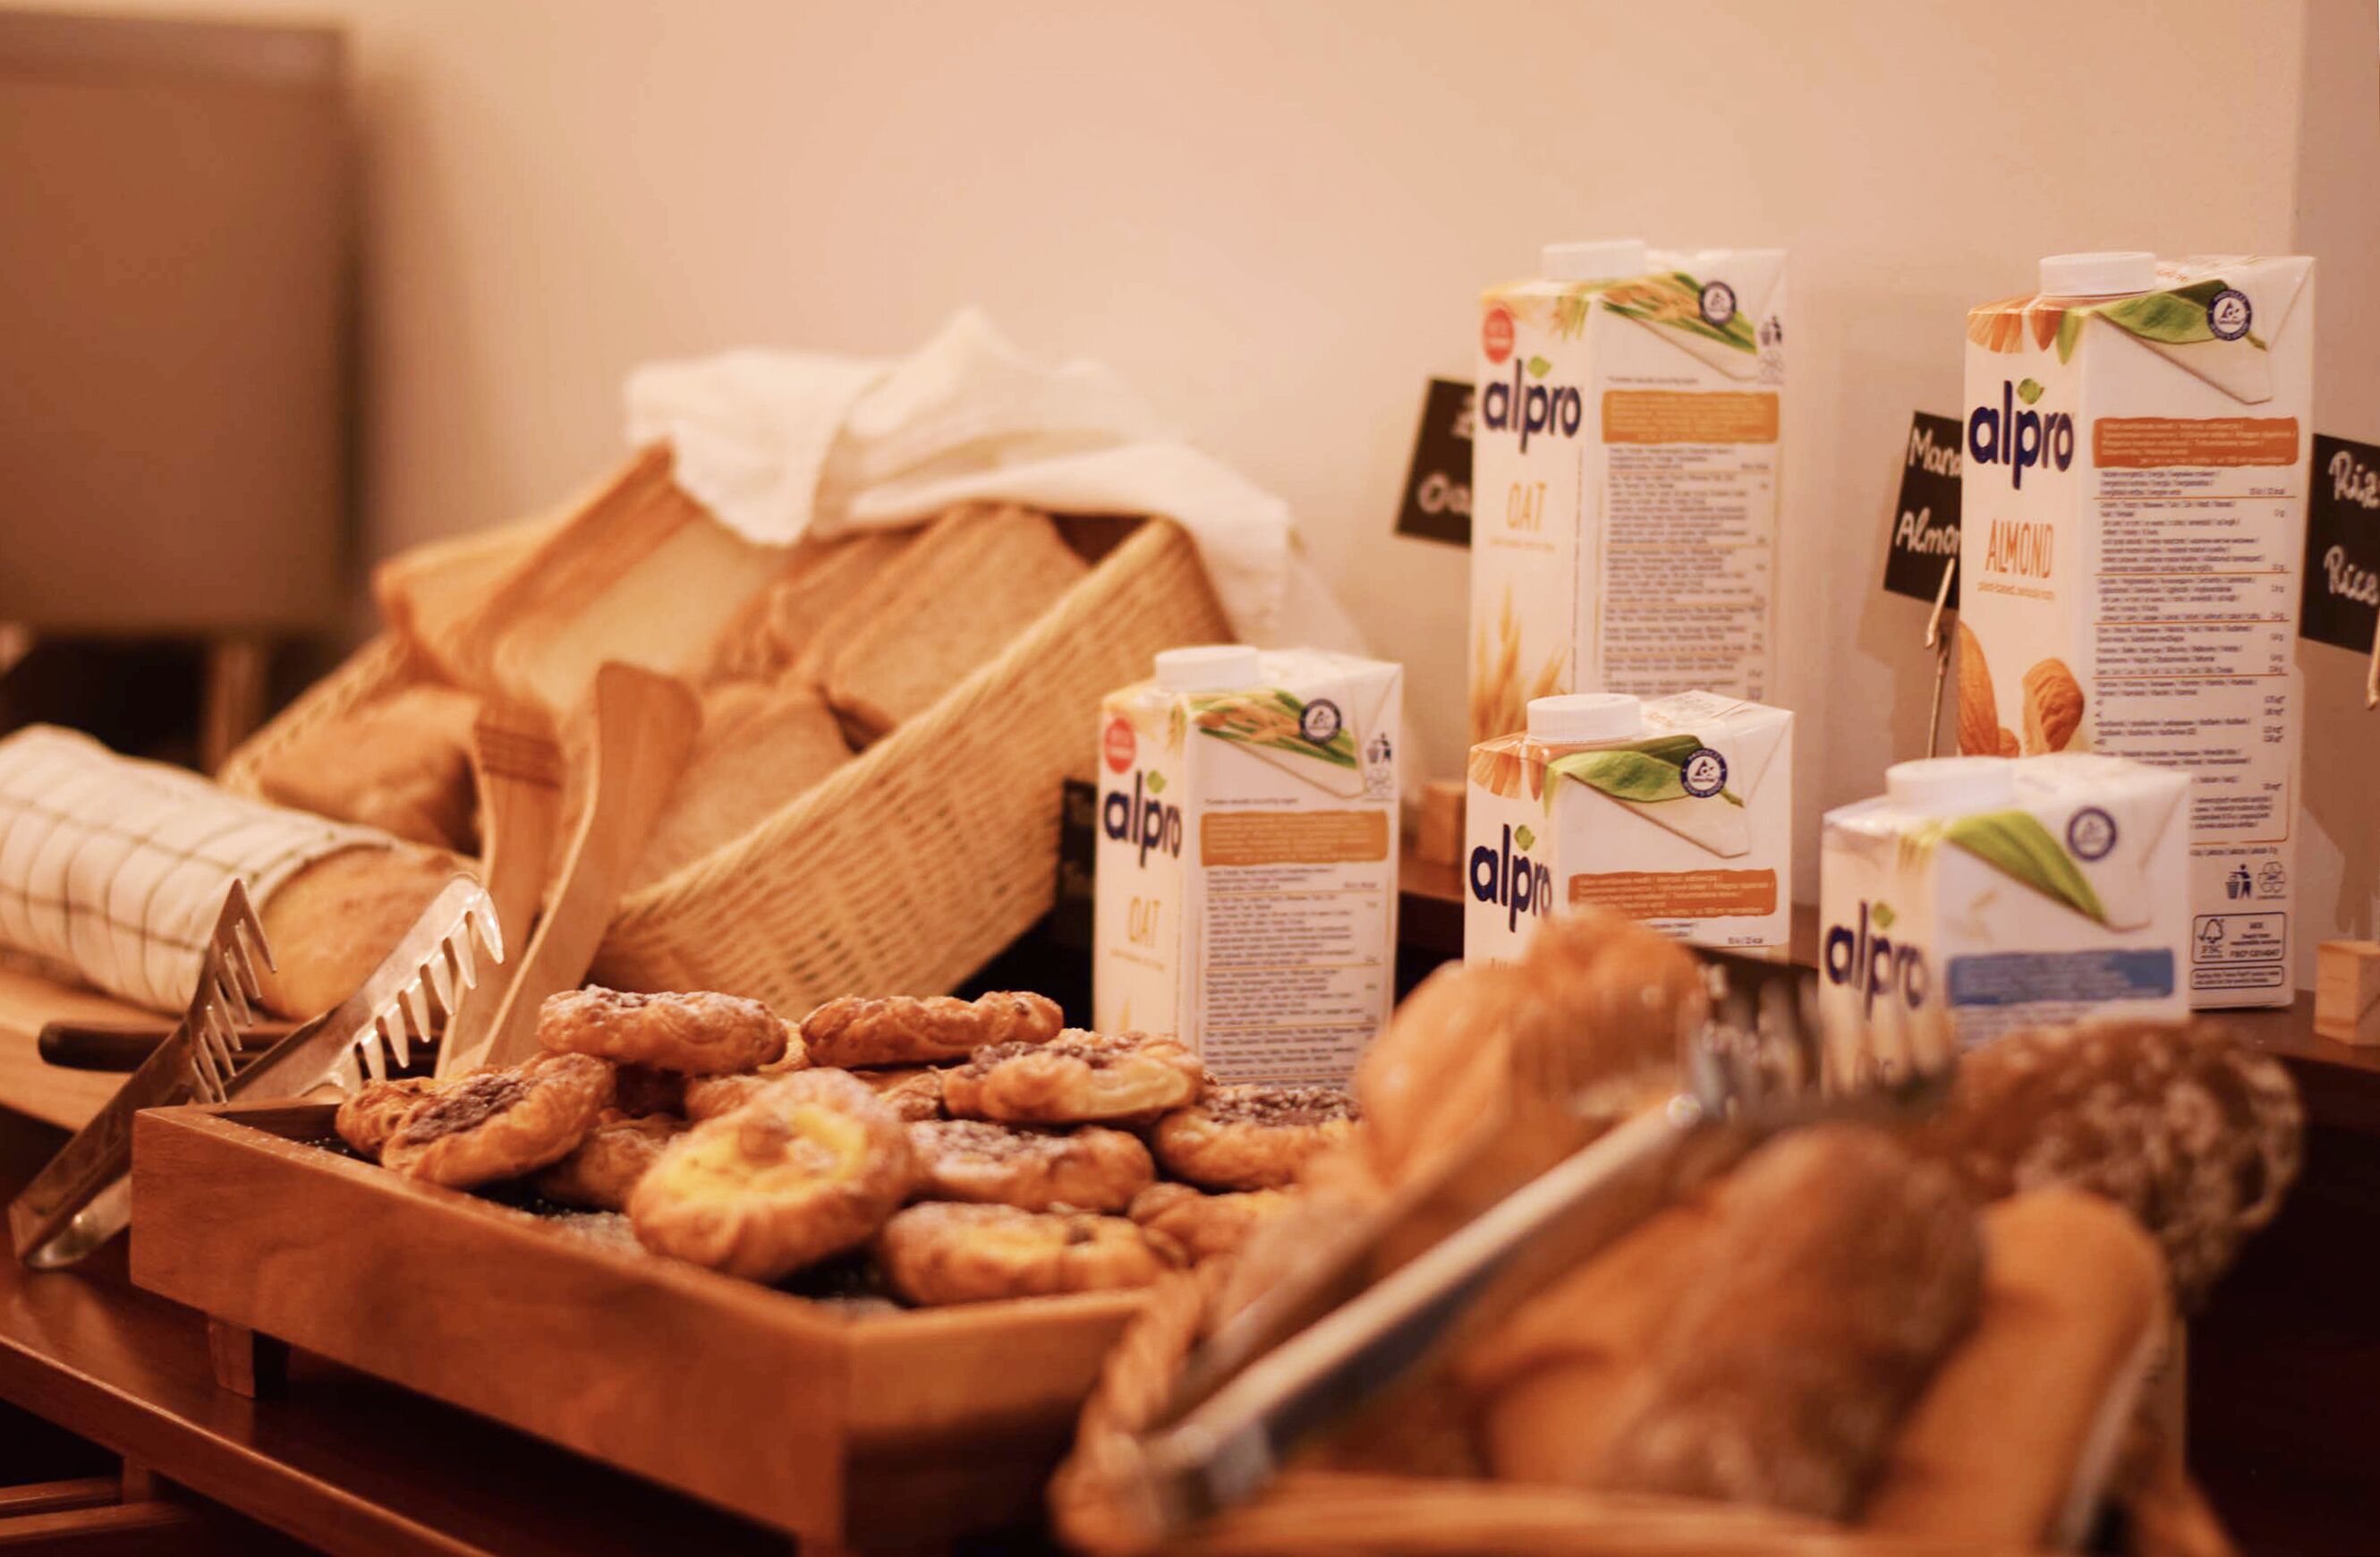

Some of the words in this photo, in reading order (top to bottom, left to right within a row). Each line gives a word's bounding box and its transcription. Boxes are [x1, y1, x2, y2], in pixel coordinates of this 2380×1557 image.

[1483, 358, 1583, 454] alpro
[1968, 379, 2074, 490] alpro
[1507, 481, 1547, 532] OAT
[1985, 518, 2054, 579] ALMOND
[1104, 770, 1182, 869] alpro
[1128, 896, 1160, 948] OAT
[1470, 823, 1552, 933] alpro
[1825, 899, 1931, 1021] alpro
